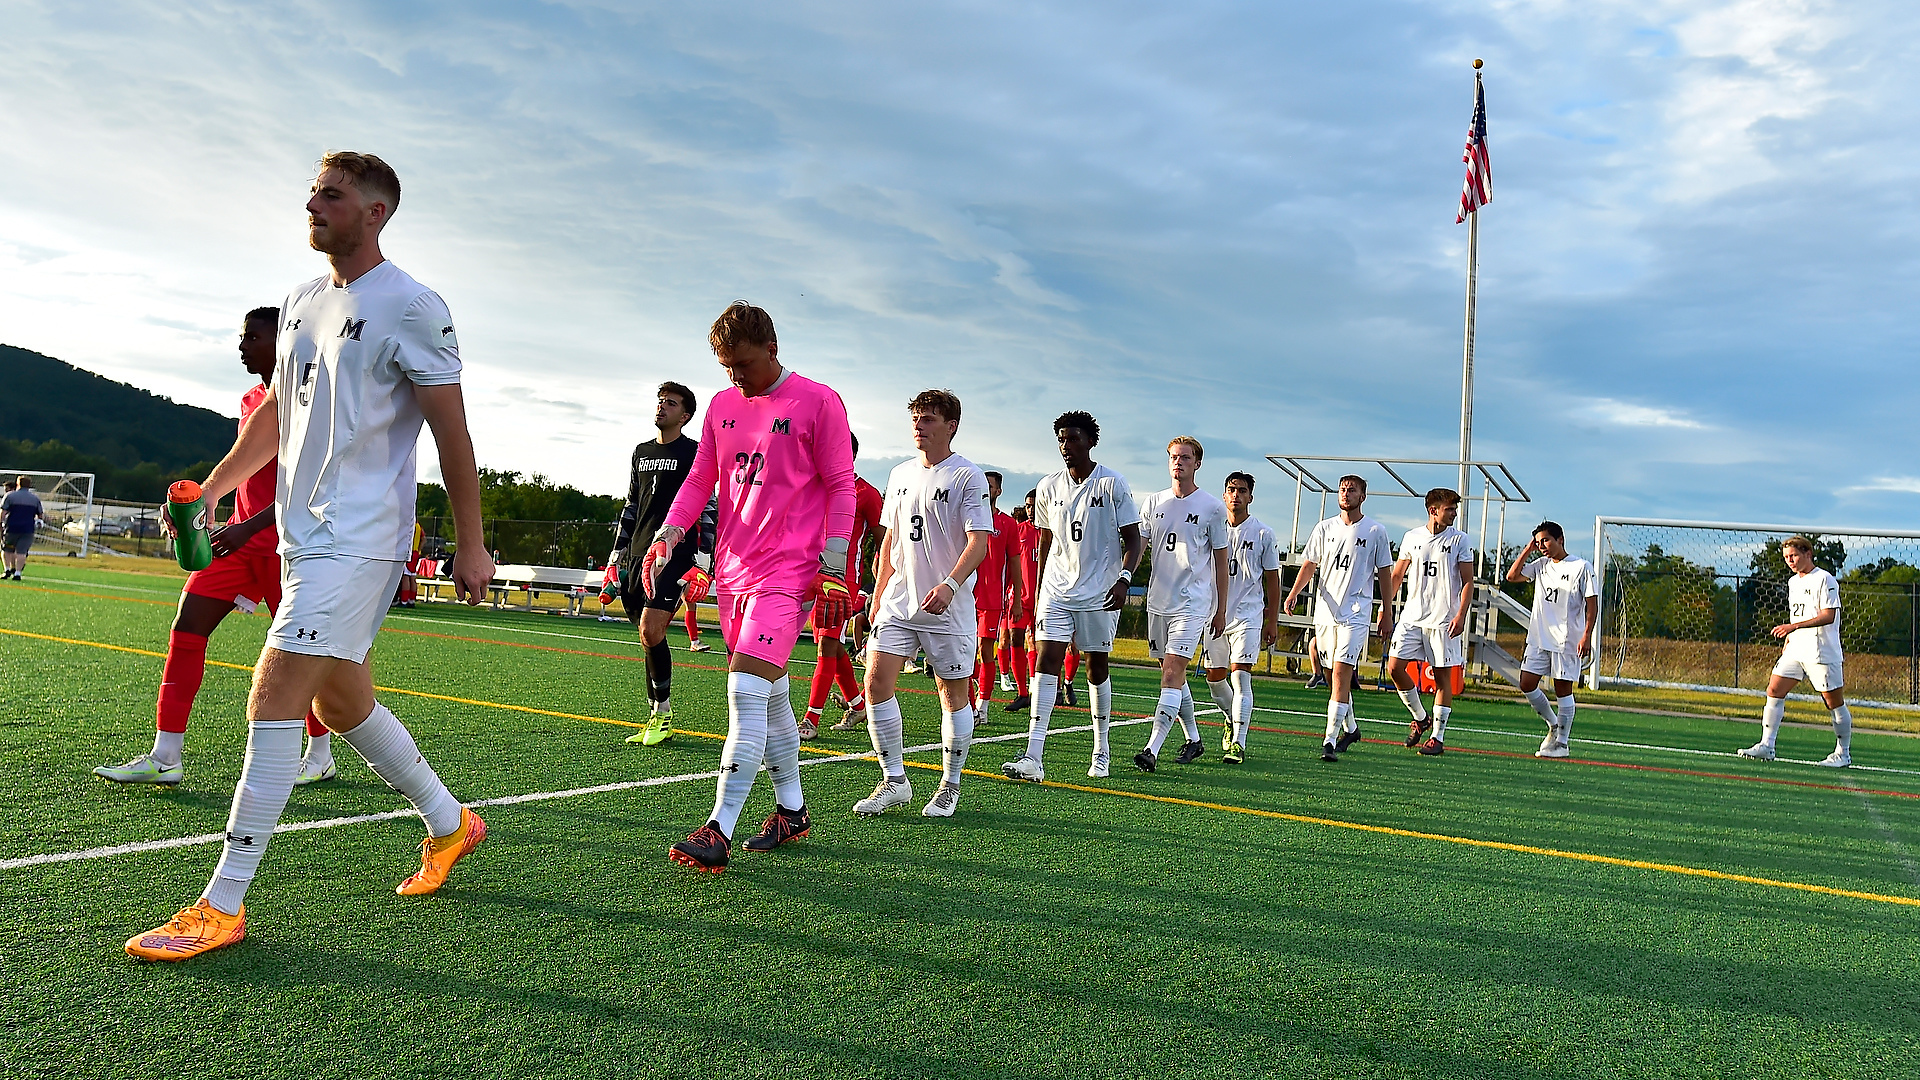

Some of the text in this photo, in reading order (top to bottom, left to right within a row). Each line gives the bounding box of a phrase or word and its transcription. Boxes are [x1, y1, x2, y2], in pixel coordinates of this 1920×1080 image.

[337, 317, 367, 342] M
[299, 362, 317, 407] 5
[769, 417, 792, 436] M
[638, 457, 678, 472] RADFORD
[735, 452, 764, 486] 32
[931, 487, 951, 503] M
[1089, 496, 1105, 508] M
[1185, 513, 1200, 525] M
[910, 515, 924, 542] 3
[1071, 520, 1083, 543] 6
[1165, 532, 1177, 552] 9
[1241, 540, 1253, 551] M
[1355, 537, 1367, 548] M
[1441, 545, 1451, 554] M
[1228, 559, 1238, 576] 0
[1334, 553, 1350, 572] 14
[1422, 561, 1438, 577] 15
[1545, 587, 1559, 604] 21
[1793, 603, 1806, 617] 27
